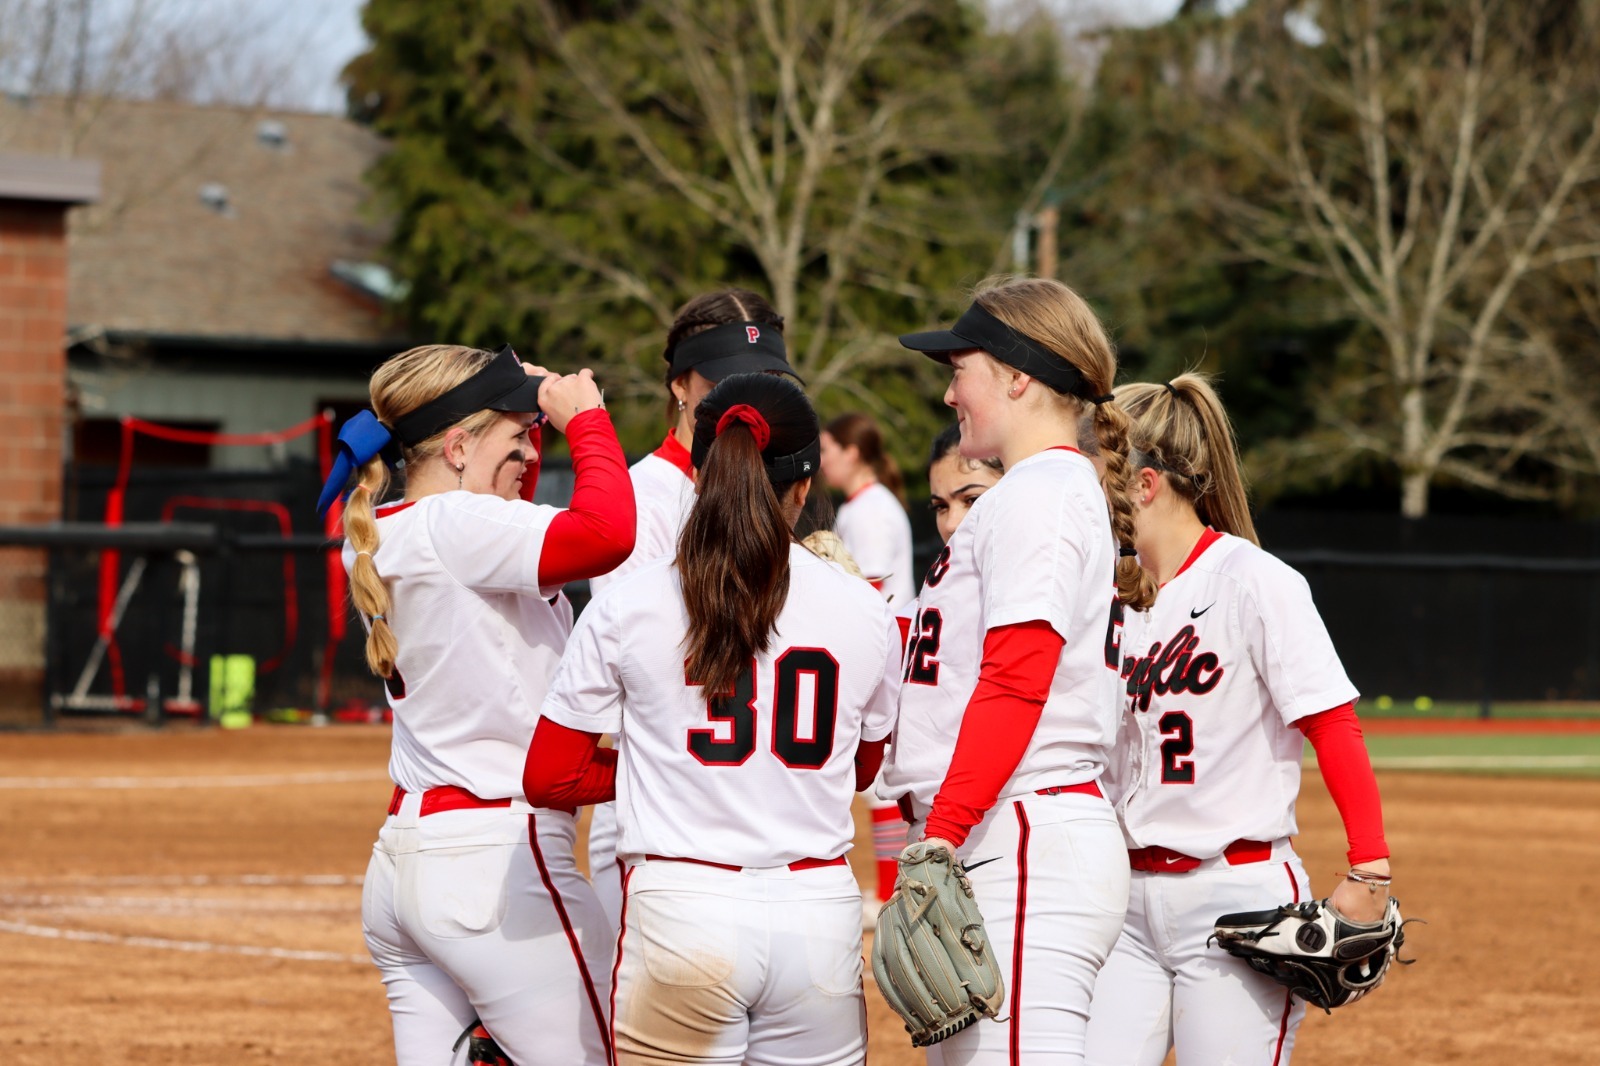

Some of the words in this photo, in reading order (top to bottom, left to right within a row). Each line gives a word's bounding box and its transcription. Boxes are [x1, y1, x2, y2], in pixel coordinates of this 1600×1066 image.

[746, 326, 760, 343] P
[684, 646, 840, 770] 30
[1158, 710, 1195, 784] 2
